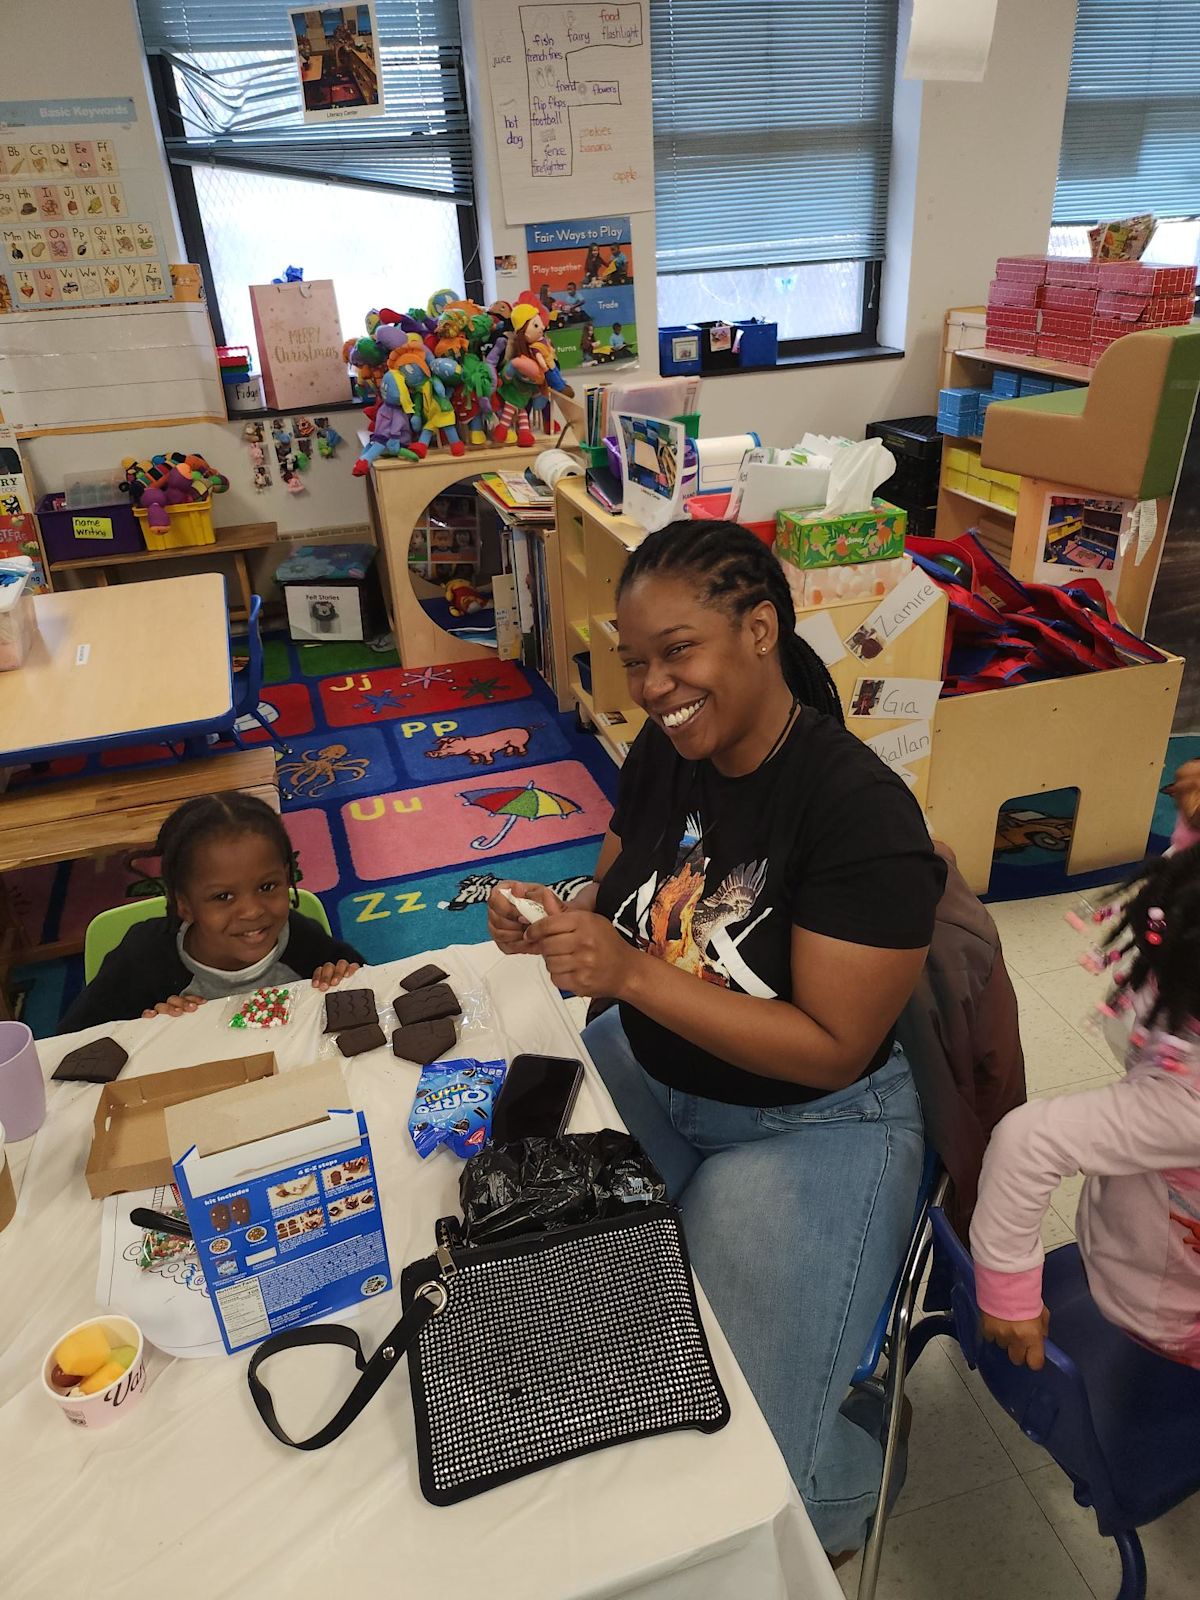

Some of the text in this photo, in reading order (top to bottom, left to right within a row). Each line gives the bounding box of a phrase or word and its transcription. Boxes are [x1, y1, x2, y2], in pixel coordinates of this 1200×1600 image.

[599, 8, 619, 23] food
[533, 34, 554, 46] fish
[567, 28, 590, 43] fairy
[602, 24, 639, 43] flashlight
[493, 55, 512, 68] juice
[40, 105, 129, 118] Basic Keywords
[505, 116, 518, 129] hot
[531, 112, 562, 127] football
[506, 131, 523, 149] dog
[7, 146, 20, 157] Bb
[30, 144, 43, 156] Cc
[51, 144, 66, 155] Dd
[97, 142, 108, 152] Ff
[17, 188, 31, 199] Hh
[63, 186, 75, 200] Jj
[84, 185, 97, 195] Kk
[3, 231, 22, 241] Mm
[49, 228, 65, 239] Oo
[72, 227, 85, 240] Pp
[115, 225, 127, 236] Rr
[534, 225, 623, 244] Fair Ways to Play
[60, 268, 73, 278] Vv
[79, 267, 97, 277] Ww
[102, 266, 117, 276] Xx
[124, 265, 136, 277] Yy
[145, 263, 157, 273] Zz
[532, 262, 582, 276] Play together
[598, 301, 619, 309] Trade
[288, 326, 321, 345] MERRY
[274, 345, 339, 363] Christmas
[557, 345, 577, 353] turns
[75, 518, 101, 527] name
[76, 527, 106, 538] writing
[873, 584, 935, 638] Zamire
[329, 674, 373, 692] Jj
[883, 689, 919, 714] Gia
[400, 720, 459, 739] Pp
[350, 797, 423, 822] Uu
[353, 891, 428, 923] Zz
[415, 1087, 491, 1115] OREO
[318, 1159, 338, 1170] steps
[204, 1187, 250, 1207] kit includes
